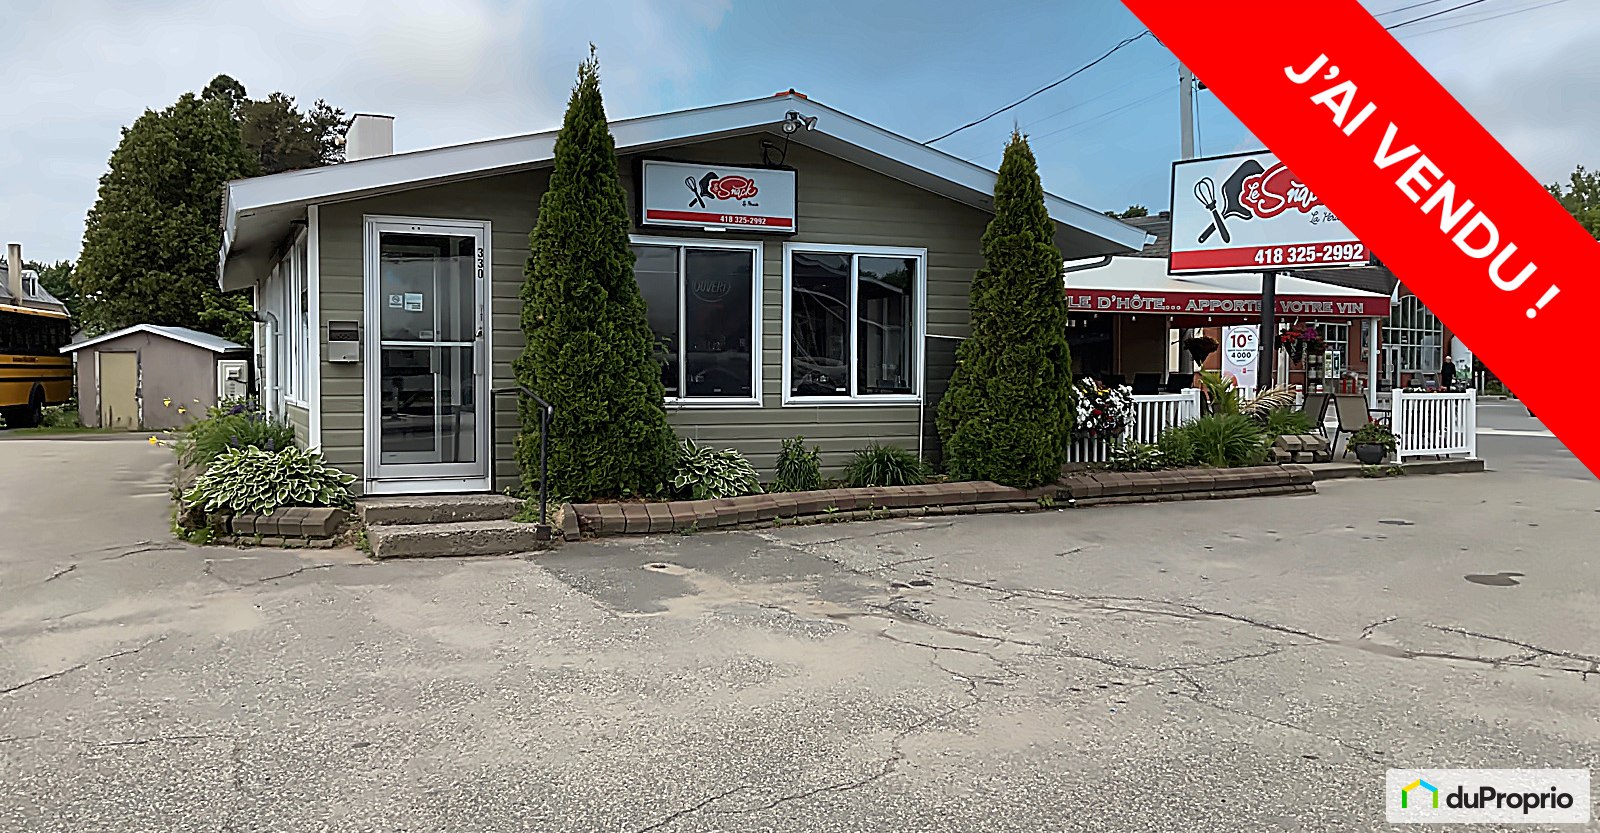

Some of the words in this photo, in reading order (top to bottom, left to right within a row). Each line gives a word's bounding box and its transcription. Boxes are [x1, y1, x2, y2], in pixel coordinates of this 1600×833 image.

[717, 177, 757, 198] Snack
[1246, 181, 1260, 203] Le
[720, 215, 733, 223] 418
[734, 216, 767, 225] 325-2992
[1254, 247, 1284, 264] 418
[1286, 243, 1365, 263] 325-2992
[1065, 295, 1091, 309] LE
[1185, 298, 1277, 312] APPORTE
[1280, 300, 1333, 314] VOTRE
[1336, 302, 1364, 314] VIN
